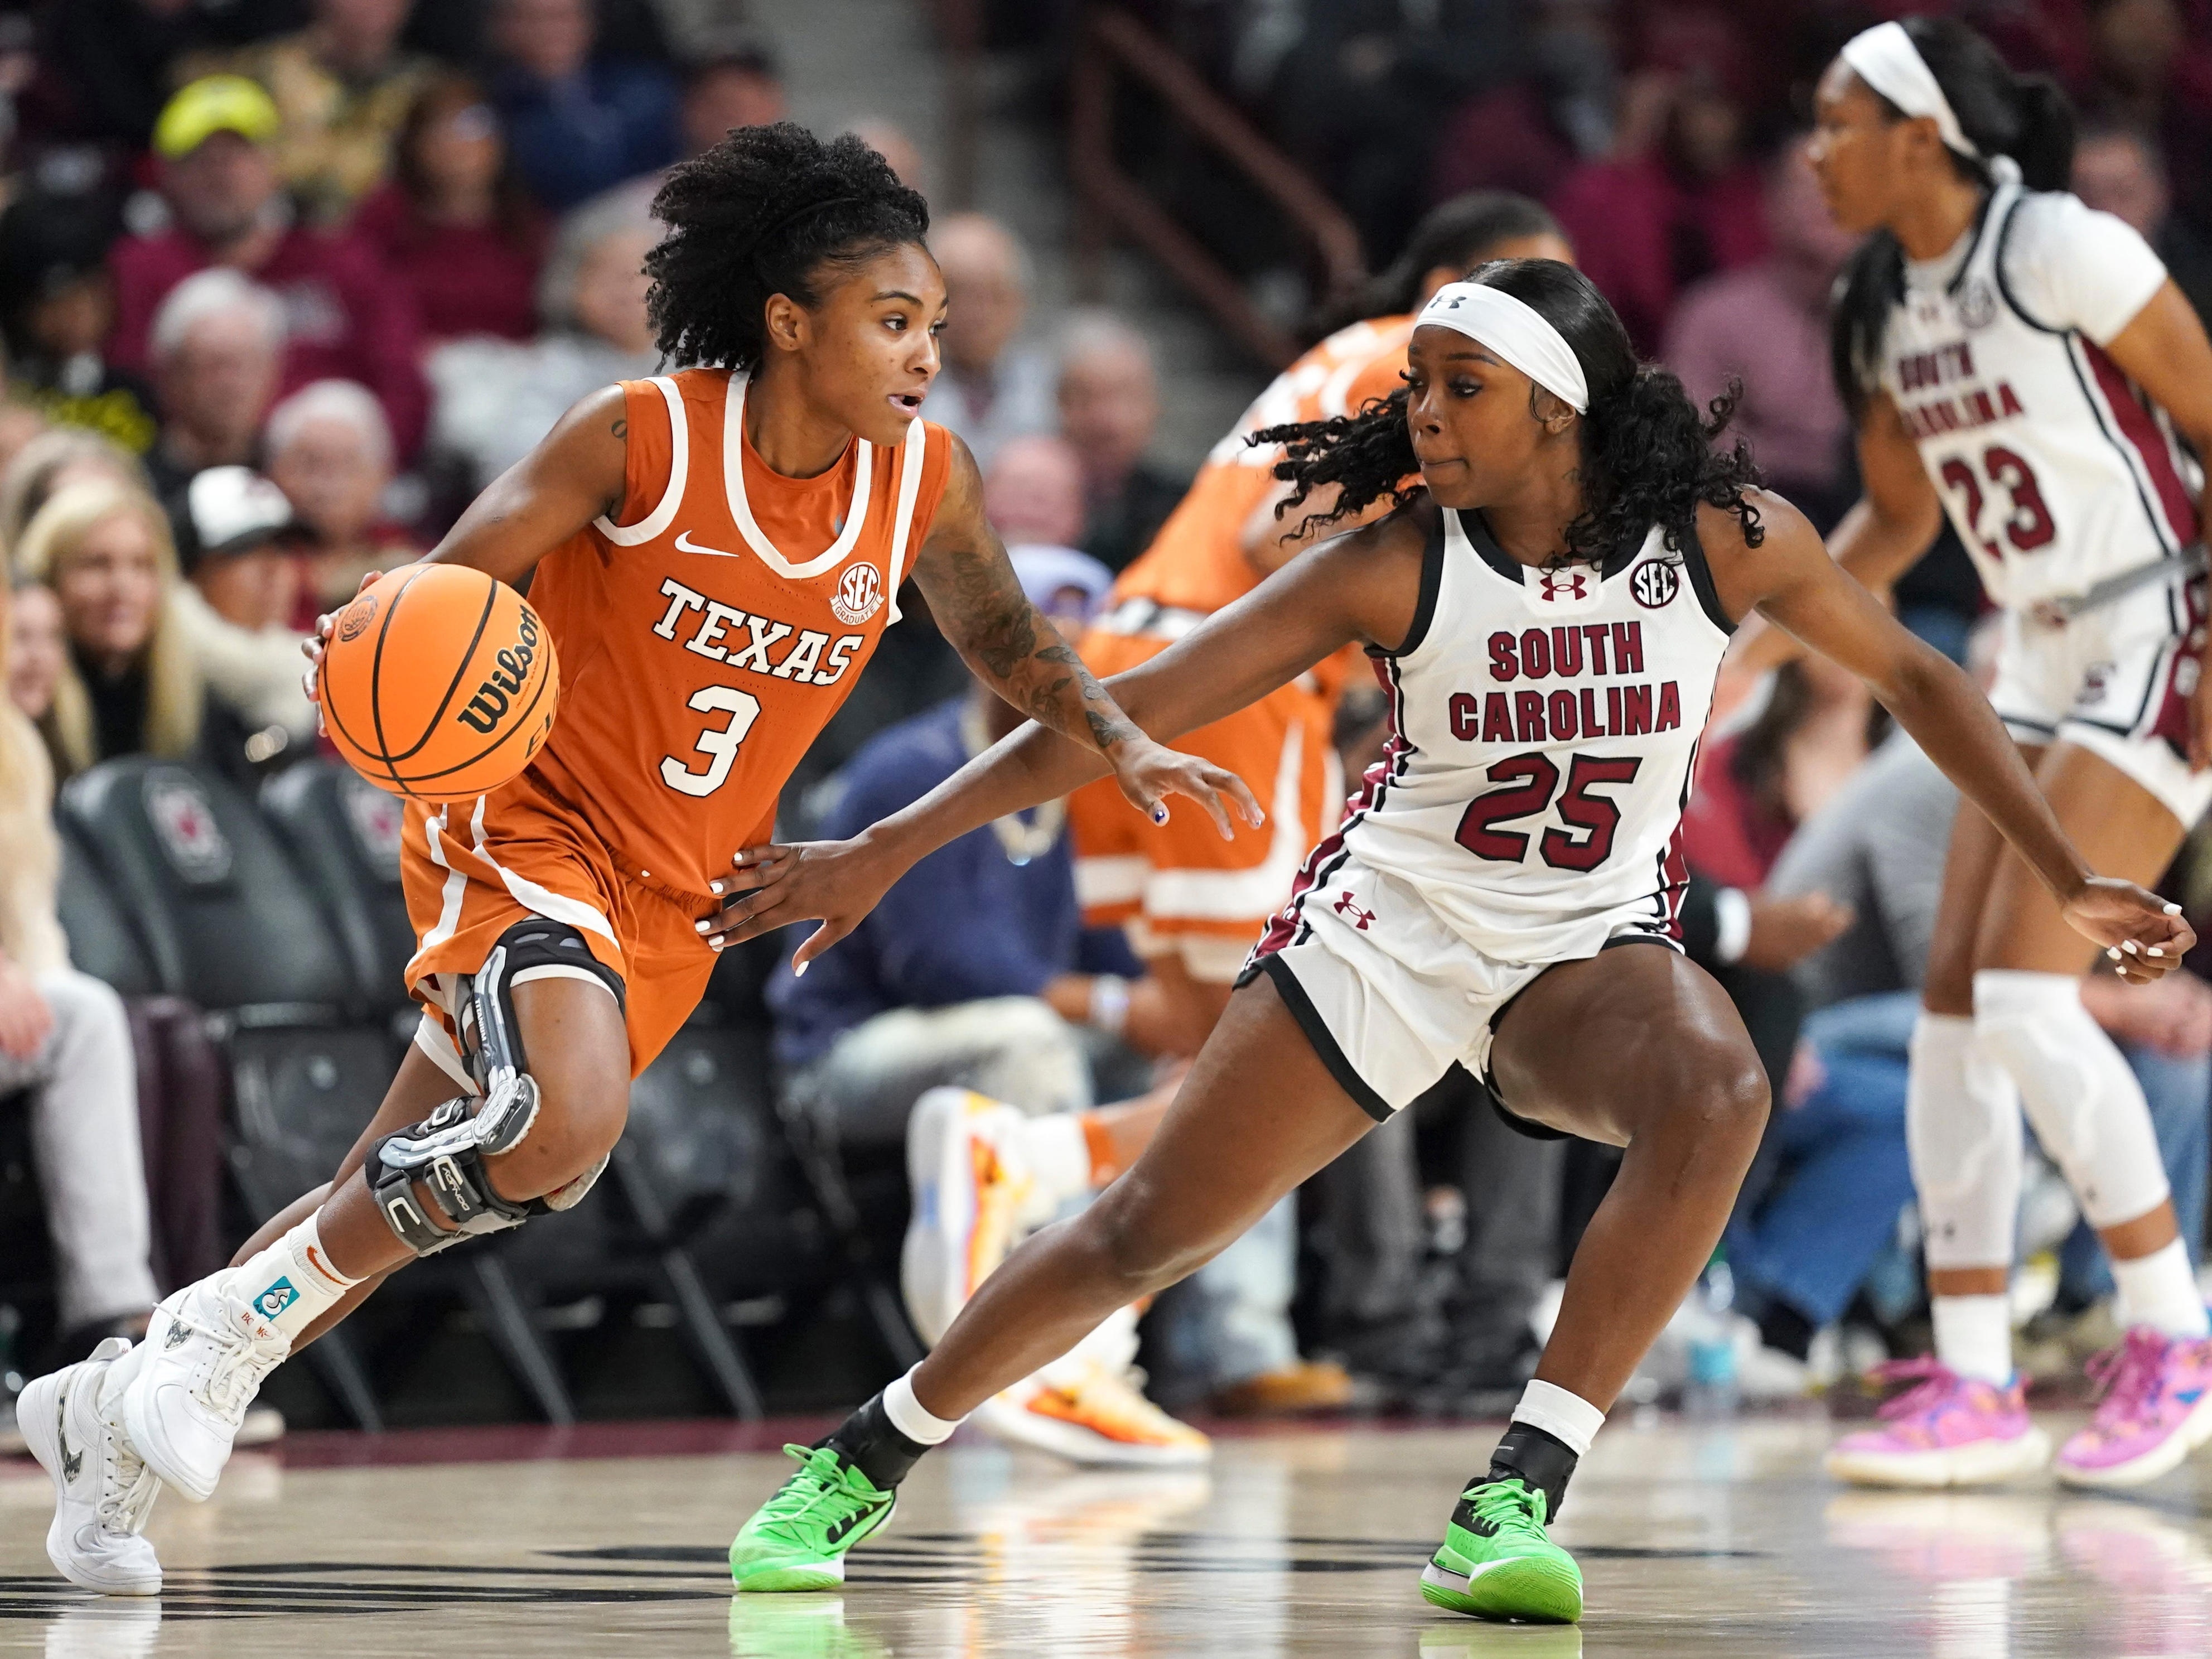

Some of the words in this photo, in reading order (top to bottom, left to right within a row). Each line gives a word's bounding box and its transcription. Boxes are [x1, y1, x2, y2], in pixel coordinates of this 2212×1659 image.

[1940, 445, 2056, 561] 23
[842, 565, 878, 610] SEC
[1635, 560, 1677, 606] SEC
[653, 576, 864, 686] TEXAS
[835, 605, 876, 624] GRADUATE
[457, 604, 539, 734] Wilson
[1487, 621, 1645, 682] SOUTH
[660, 684, 762, 798] 3
[1448, 681, 1681, 742] CAROLINA
[1454, 752, 1644, 873] 25
[475, 997, 487, 1042] TITANIUM
[442, 1168, 470, 1212] DONJOY
